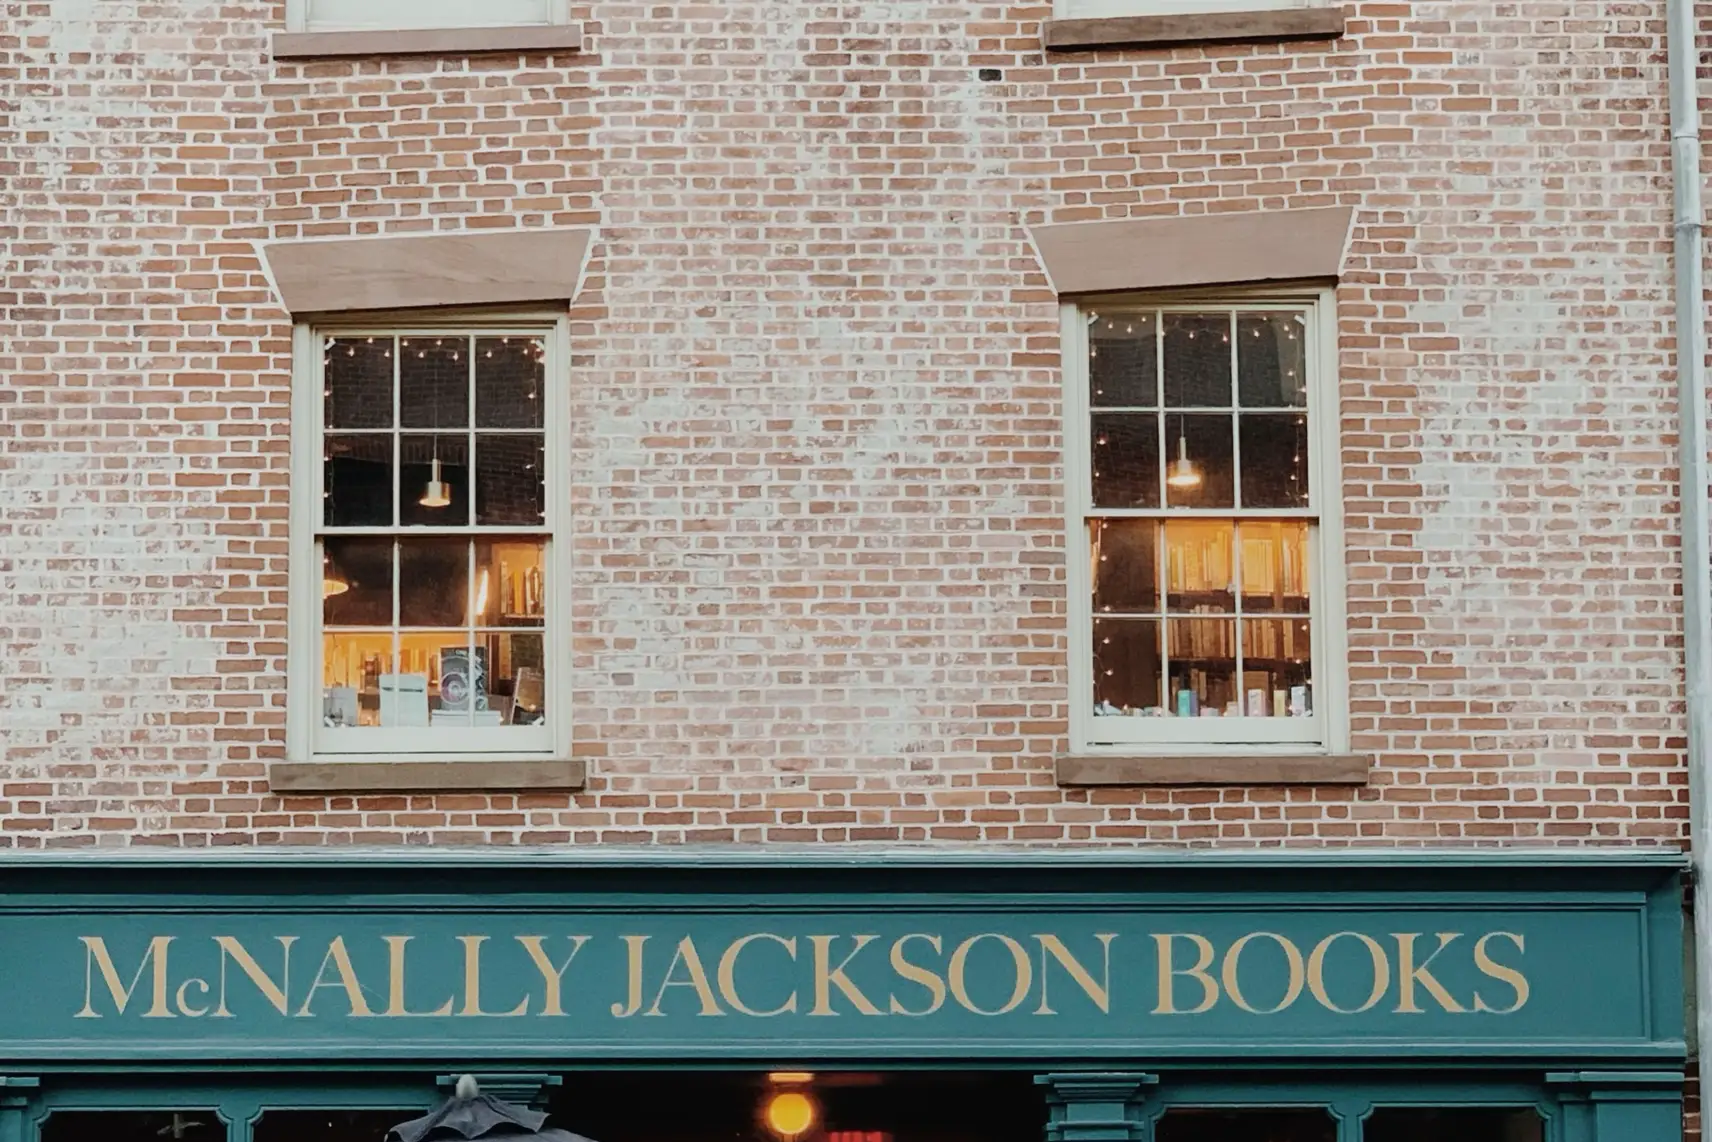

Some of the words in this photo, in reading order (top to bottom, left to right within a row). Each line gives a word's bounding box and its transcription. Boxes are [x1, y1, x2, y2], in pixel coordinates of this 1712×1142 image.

[72, 934, 592, 1019] McNALLY
[610, 933, 1120, 1018] JACKSON
[1149, 931, 1530, 1015] BOOKS
